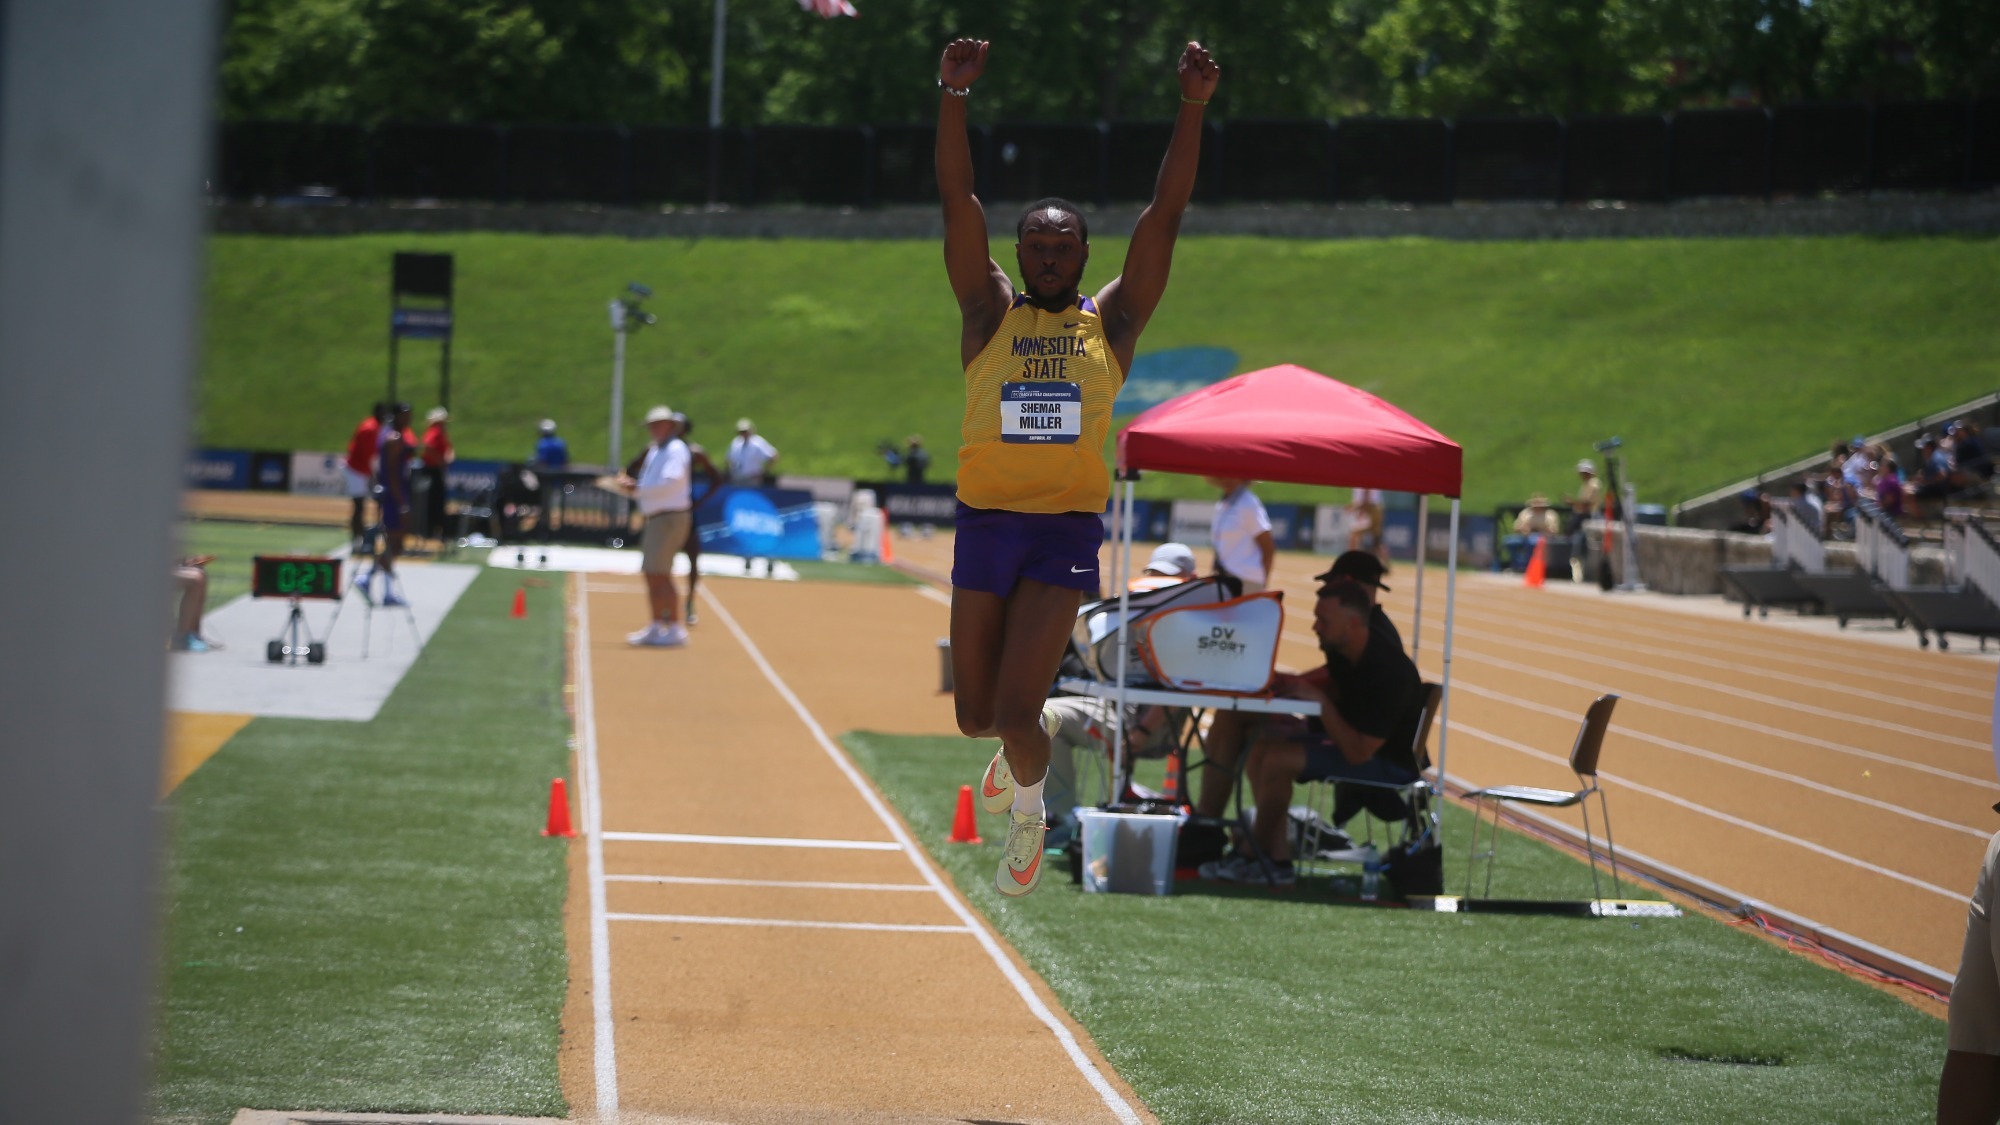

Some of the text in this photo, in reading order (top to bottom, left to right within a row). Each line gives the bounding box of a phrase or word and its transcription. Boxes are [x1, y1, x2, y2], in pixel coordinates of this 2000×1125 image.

[1011, 335, 1086, 357] MINNESOTA
[1022, 357, 1067, 379] STATE
[1020, 403, 1061, 414] SHEMAR
[1019, 416, 1062, 430] MILLER
[1211, 626, 1235, 640] DV
